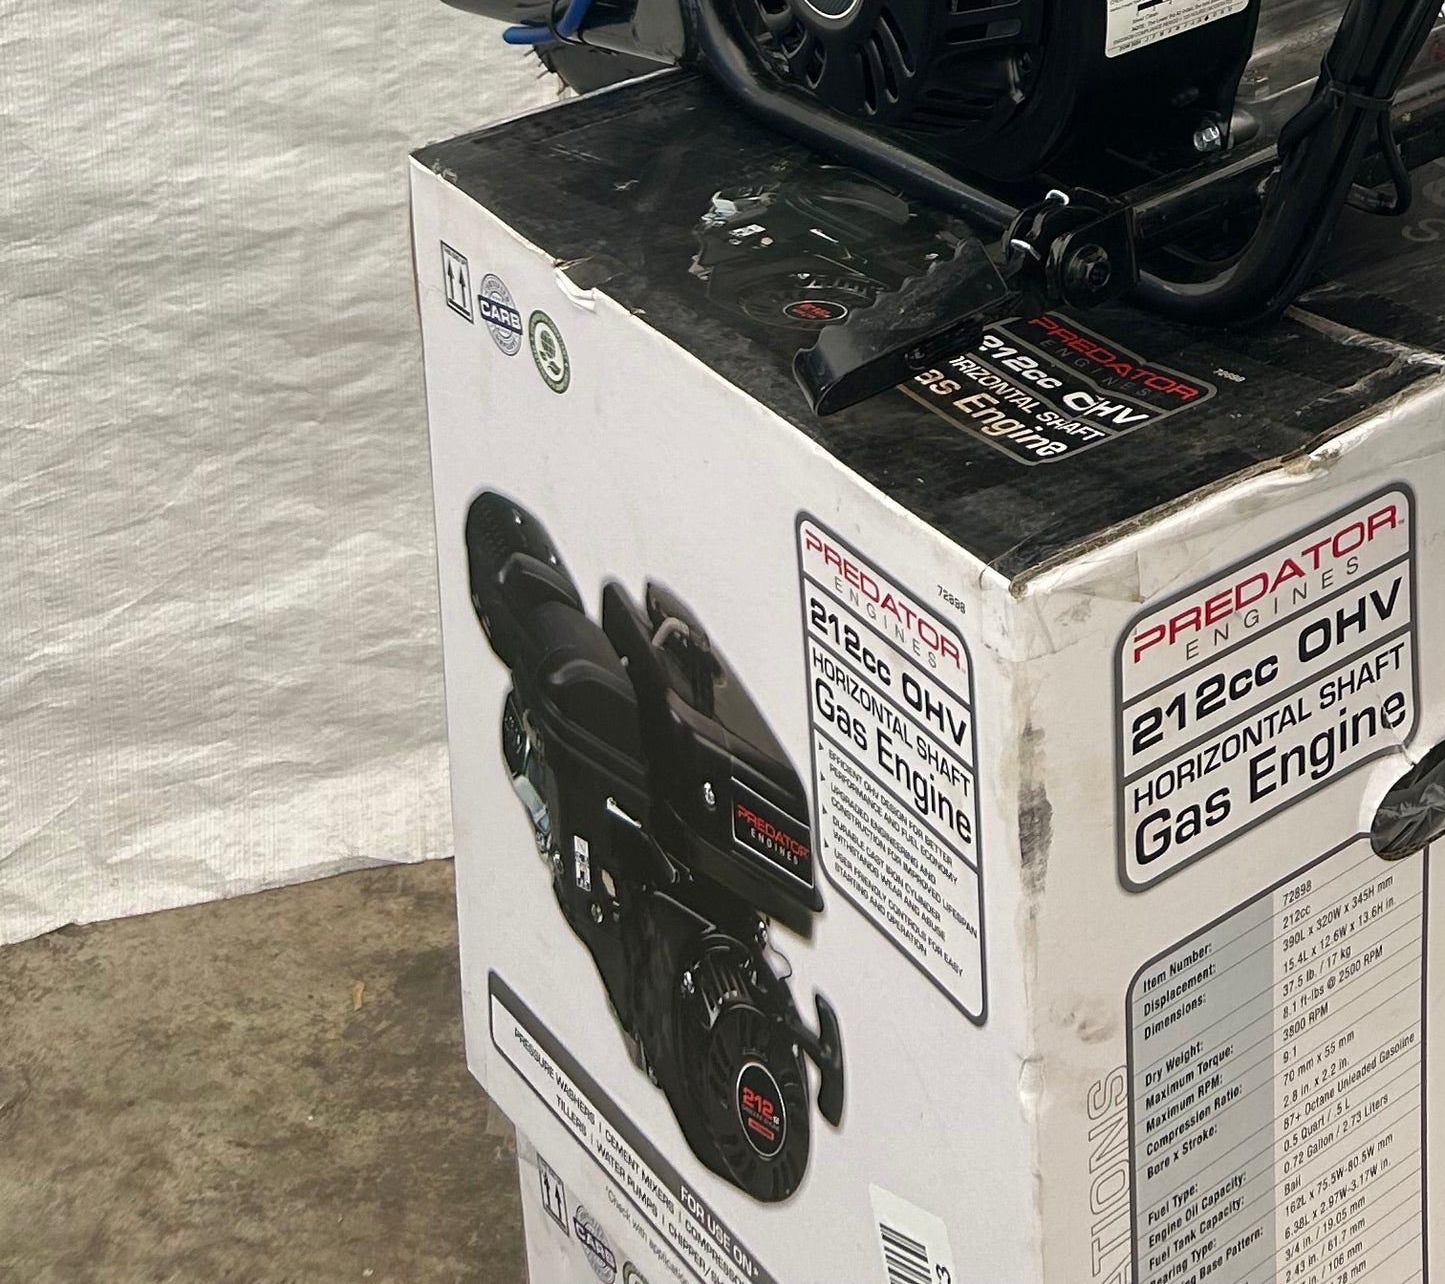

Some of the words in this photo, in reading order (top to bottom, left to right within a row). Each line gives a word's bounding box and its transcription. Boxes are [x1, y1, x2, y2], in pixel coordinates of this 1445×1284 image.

[480, 300, 521, 330] CARB
[1029, 317, 1199, 401] PREDATOR
[953, 392, 1068, 458] Engine
[1036, 411, 1105, 441] SHAFT
[1062, 391, 1149, 424] OHV
[805, 529, 961, 670] PREDATOR
[1133, 504, 1396, 664] PREDATOR
[1186, 556, 1359, 661] ENGINES
[834, 575, 937, 669] ENGINES
[810, 597, 892, 686] 212cc
[902, 672, 967, 747] OHV
[1132, 655, 1278, 756] 212cc
[1298, 576, 1402, 662] OHV
[812, 647, 913, 748] HORIZONTAL
[917, 733, 970, 797] SHAFT
[1134, 698, 1312, 814] HORIZONTAL
[1319, 642, 1405, 710] SHAFT
[815, 678, 868, 751] Gas
[877, 726, 972, 845] Engine
[1135, 787, 1231, 865] Gas
[1250, 691, 1406, 804] Engine
[736, 804, 809, 859] PREDATOR
[1282, 879, 1311, 906] 72898
[1282, 929, 1304, 951] 390L
[1308, 925, 1313, 934] x
[1316, 906, 1340, 930] 320W
[1344, 903, 1349, 913] x
[1352, 885, 1374, 908] 345H
[1377, 876, 1392, 892] mm
[1282, 905, 1310, 929] 212cc
[1144, 971, 1166, 992] Item
[1169, 943, 1212, 978] Number:
[1283, 950, 1308, 973] 15.4L
[1312, 946, 1316, 955] x
[1320, 924, 1346, 950] 12.6W
[1350, 922, 1354, 930] x
[1358, 902, 1382, 925] 13.6H
[1283, 974, 1302, 996] 37.5
[1327, 952, 1337, 968] 17
[1340, 946, 1350, 959] kg
[1144, 963, 1215, 1015] Displacement:
[1144, 993, 1205, 1039] Dimensions:
[1283, 1001, 1296, 1019] 8.1
[1300, 984, 1323, 1007] ft-lbs
[1327, 975, 1335, 990] @
[1339, 959, 1360, 982] 2500
[1364, 944, 1382, 966] RPM
[1283, 1017, 1305, 1041] 3800
[1308, 1002, 1328, 1024] RPM
[1145, 1068, 1162, 1087] Dry
[1166, 1040, 1202, 1073] Weight:
[1146, 1070, 1193, 1109] Maximum
[1197, 1045, 1233, 1075] Torque:
[1283, 1069, 1294, 1086] 70
[1298, 1058, 1313, 1076] mm
[1316, 1053, 1321, 1063] x
[1324, 1041, 1335, 1058] 55
[1338, 1030, 1354, 1048] mm
[1284, 1113, 1300, 1130] 87+
[1304, 1088, 1334, 1115] Octane
[1337, 1057, 1376, 1093] Unleaded
[1379, 1032, 1414, 1063] Gasoline
[1146, 1093, 1194, 1132] Maximum
[1198, 1073, 1222, 1097] RPM:
[1146, 1105, 1210, 1156] Compression
[1214, 1085, 1241, 1109] Ratio:
[1283, 1151, 1303, 1174] 0.72
[1306, 1132, 1333, 1158] Gallon
[1343, 1110, 1361, 1133] 2.73
[1364, 1094, 1388, 1117] Liters
[555, 1072, 595, 1125] WASHERS
[605, 1128, 638, 1175] CEMENT
[642, 1169, 674, 1214] MIXERS
[556, 1093, 586, 1136] TILLERS
[597, 1140, 625, 1181] WATER
[627, 1174, 657, 1217] PUMPS
[1147, 1156, 1169, 1179] Bore
[1173, 1150, 1179, 1161] x
[1182, 1124, 1217, 1154] Stroke:
[681, 1185, 704, 1224] FOR
[708, 1214, 730, 1252] USE
[1148, 1201, 1168, 1225] Fuel
[1172, 1183, 1197, 1208] Type:
[1149, 1216, 1181, 1247] Engine
[1185, 1203, 1197, 1221] Oil
[1201, 1172, 1246, 1210] Capacity:
[1284, 1175, 1300, 1195] Ball
[1149, 1246, 1169, 1270] Fuel
[1173, 1228, 1196, 1253] Tank
[1200, 1196, 1243, 1234] Capacity:
